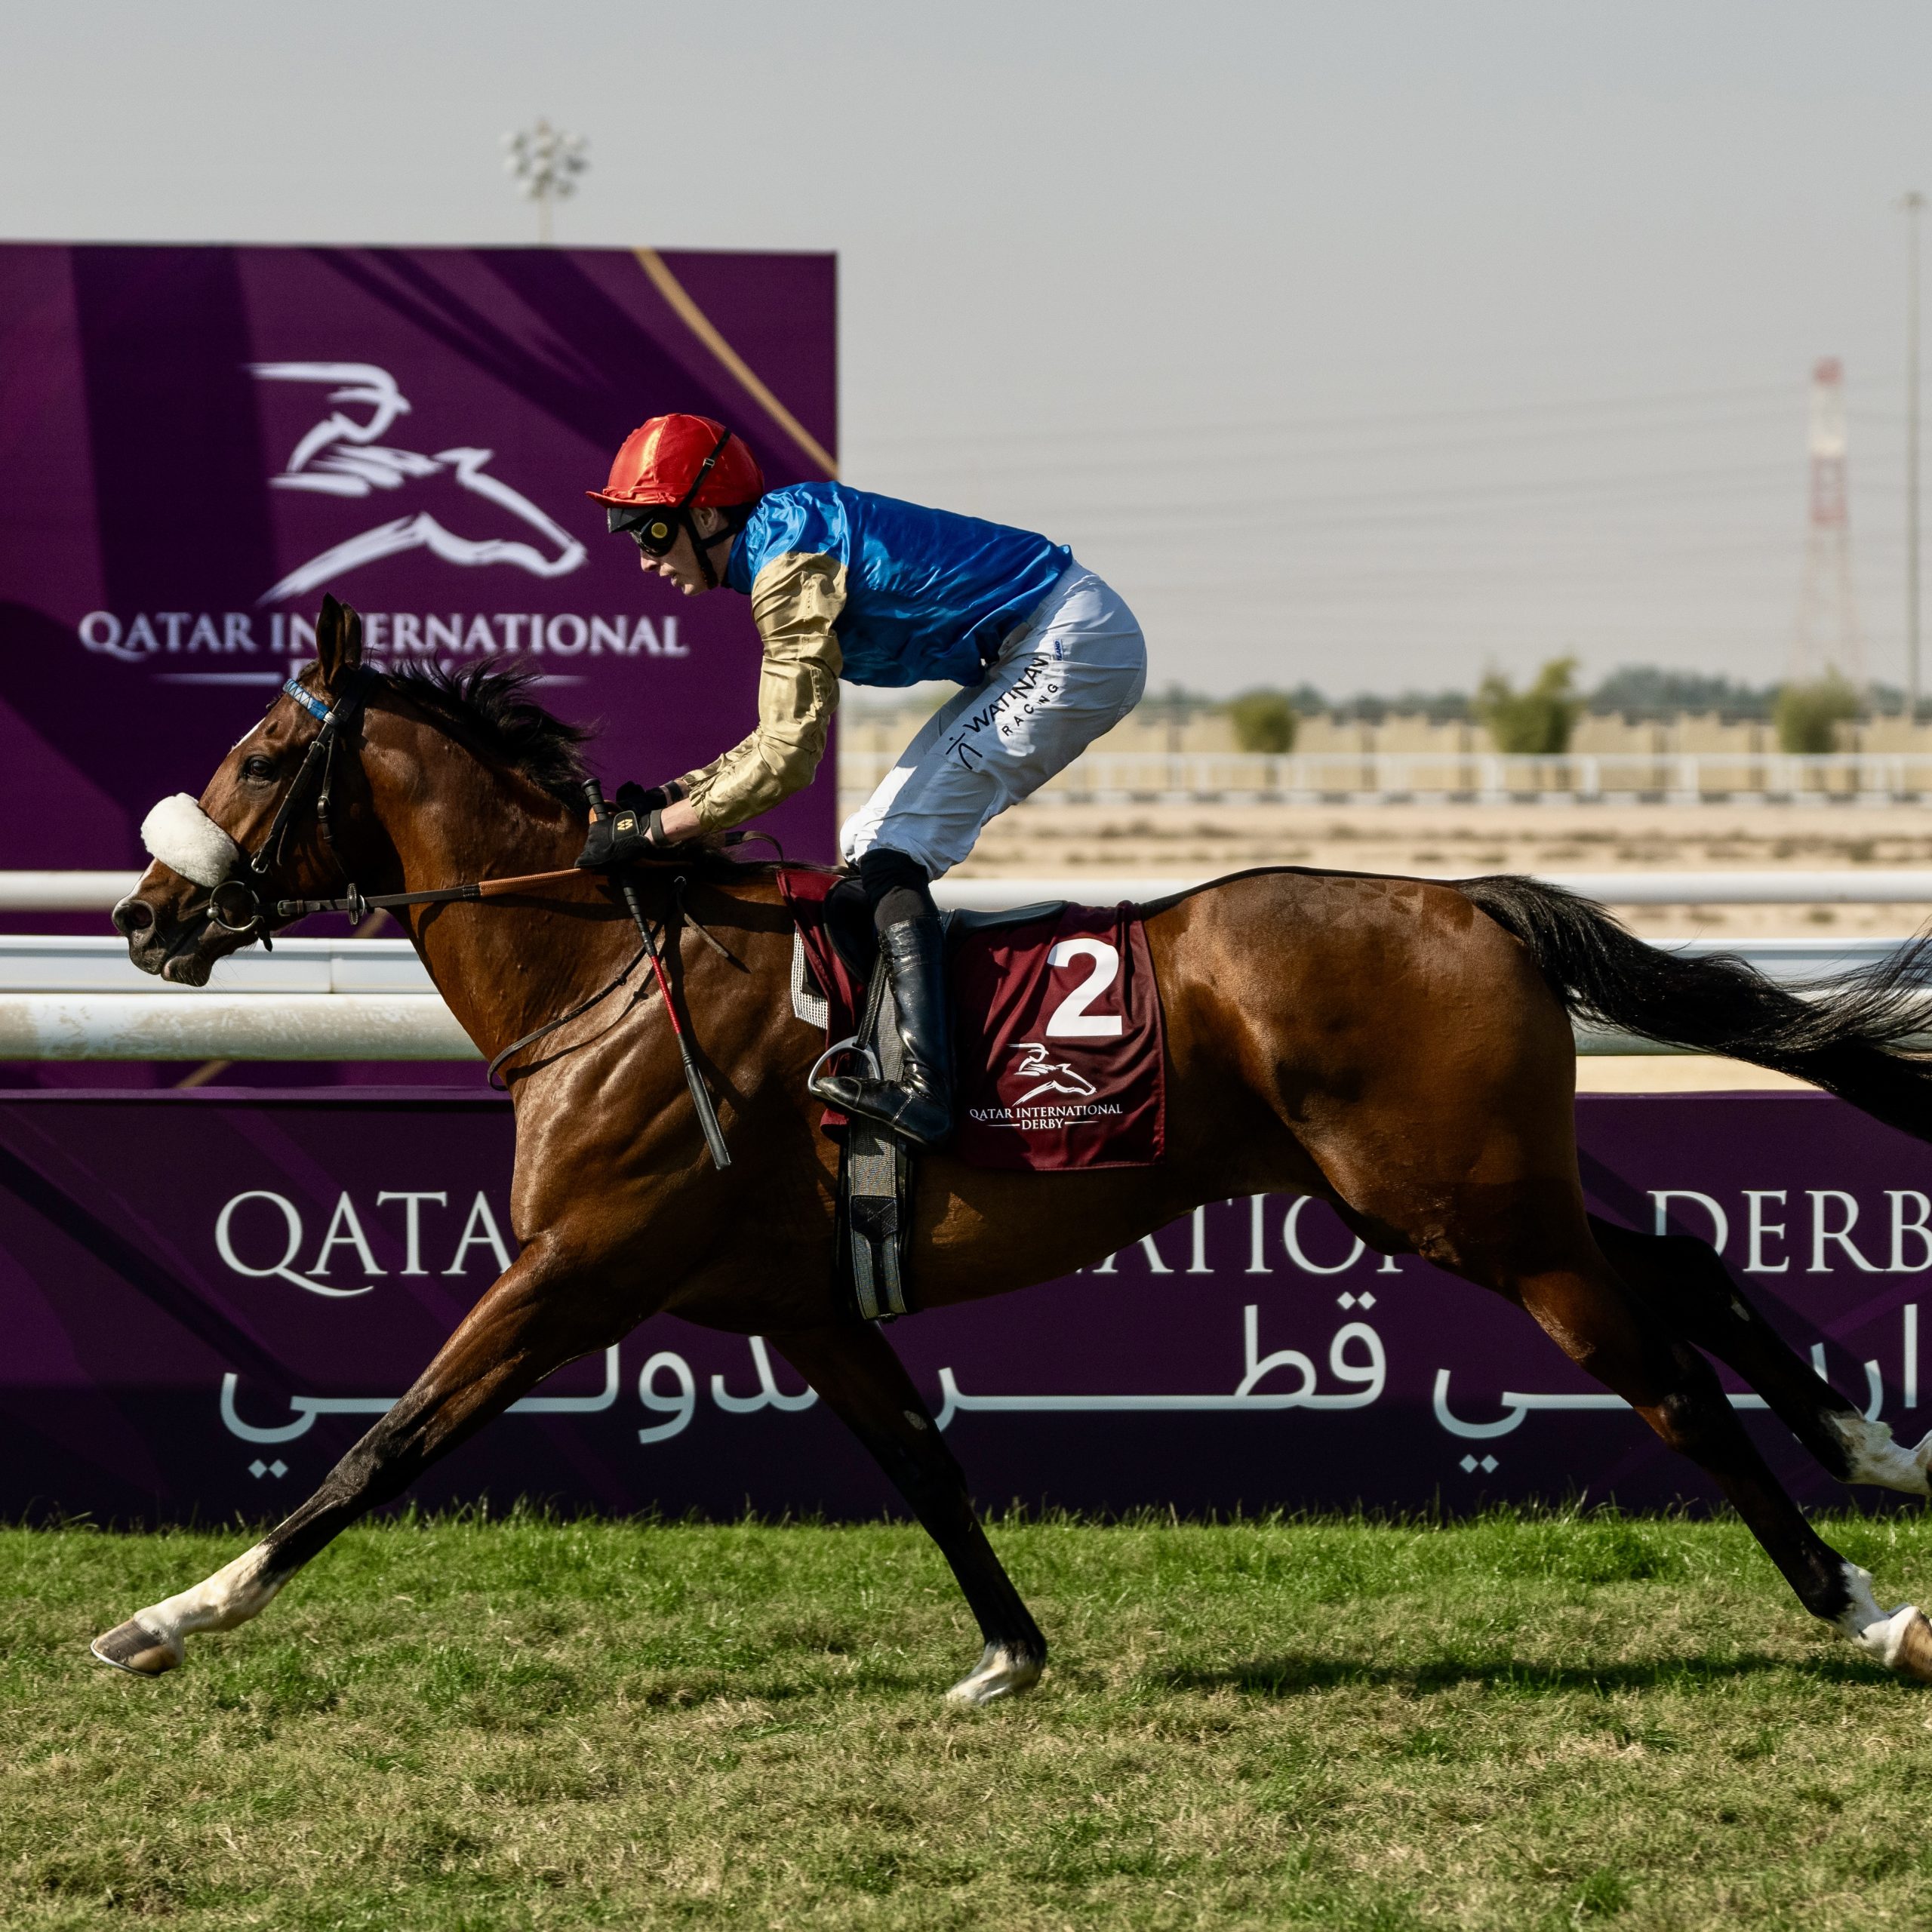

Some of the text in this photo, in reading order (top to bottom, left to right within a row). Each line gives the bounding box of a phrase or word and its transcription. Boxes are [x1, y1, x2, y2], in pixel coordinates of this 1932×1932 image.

[78, 611, 691, 663] QATAR INERNATIONAL
[1001, 682, 1058, 737] RACNG
[1045, 937, 1123, 1037] 2
[969, 1103, 1123, 1121] QATAR INTERNATIONAL
[1021, 1118, 1064, 1131] DERBY
[214, 1189, 513, 1298] QATA
[934, 1291, 1386, 1432] قطر
